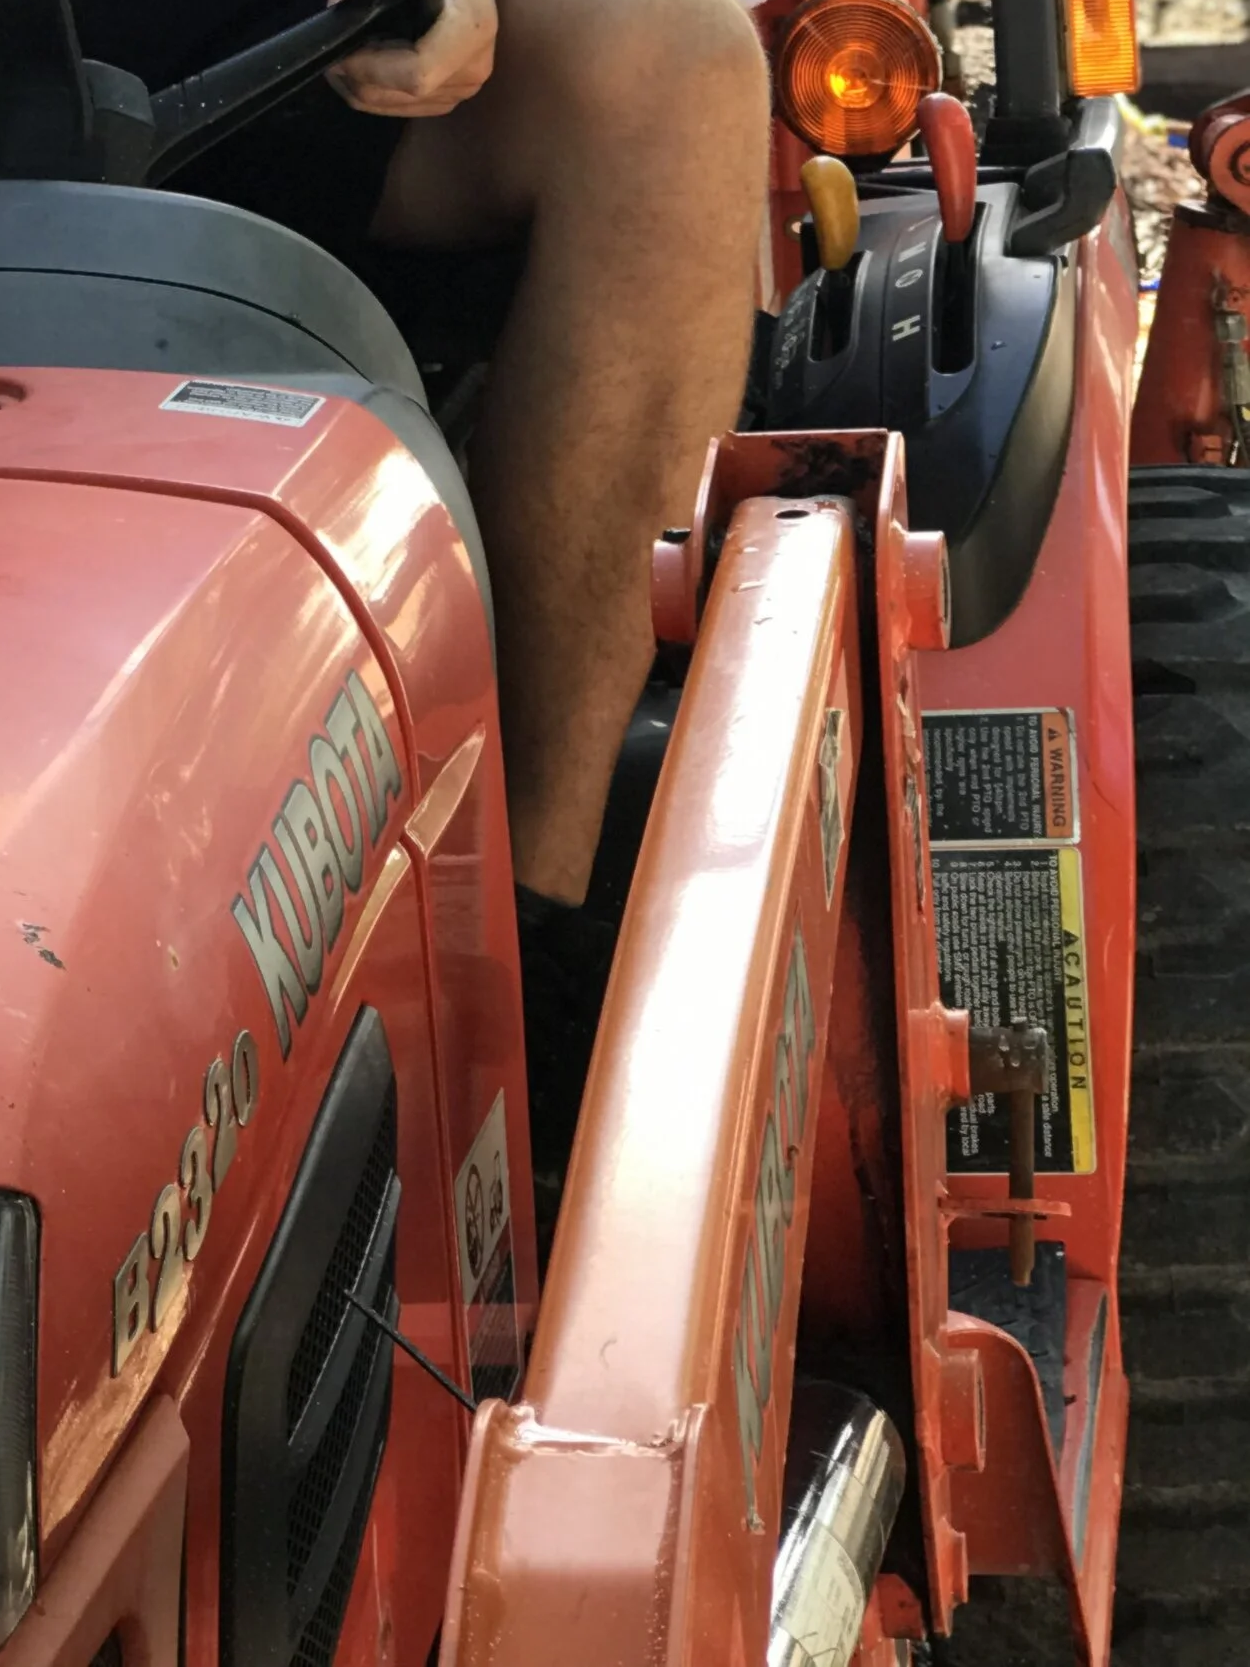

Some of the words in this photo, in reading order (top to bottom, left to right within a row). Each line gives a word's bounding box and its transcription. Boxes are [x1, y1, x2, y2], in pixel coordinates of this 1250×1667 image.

[892, 315, 921, 342] H
[972, 794, 980, 812] PTO
[1050, 748, 1066, 826] WARNING
[1020, 812, 1029, 830] PTO
[230, 668, 403, 1064] KUBOTA
[1049, 855, 1058, 867] TO
[1050, 869, 1059, 896] AVOID
[1050, 898, 1060, 946] PERSONAL
[1066, 951, 1086, 1089] CAUTION
[1043, 1122, 1052, 1157] distance
[112, 1030, 258, 1378] B2320
